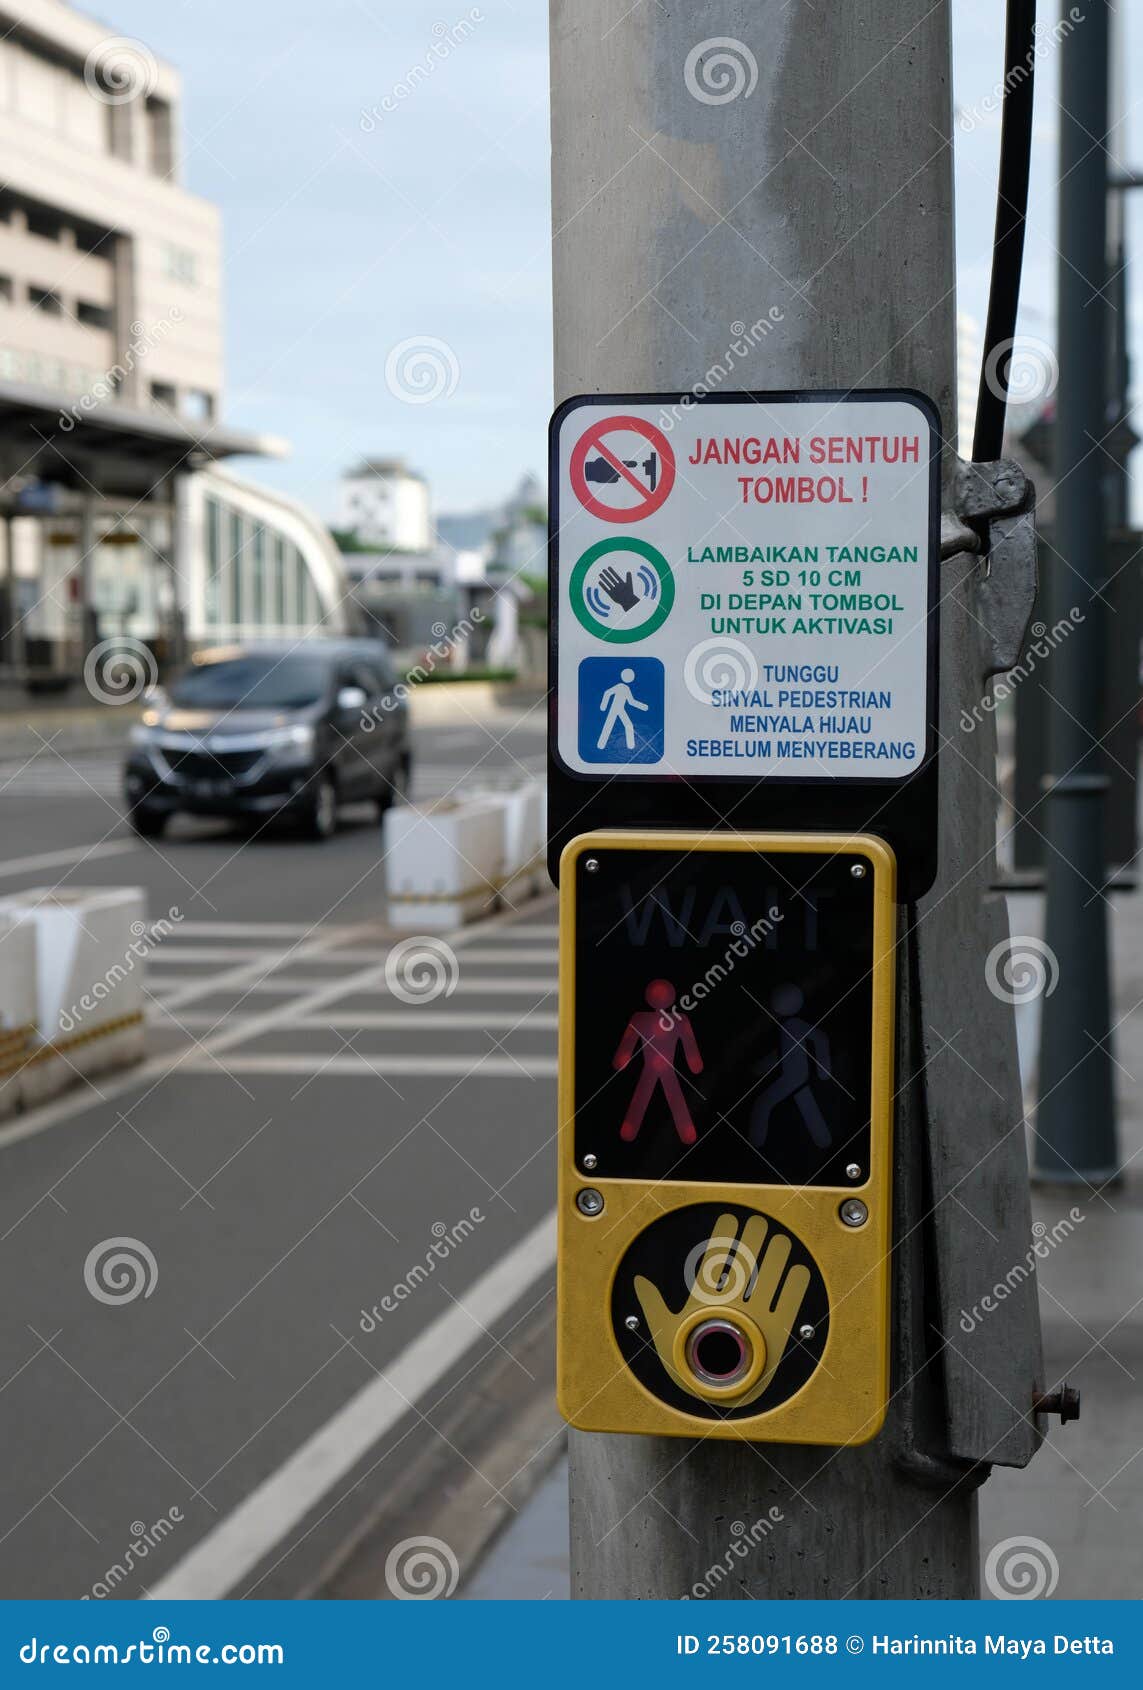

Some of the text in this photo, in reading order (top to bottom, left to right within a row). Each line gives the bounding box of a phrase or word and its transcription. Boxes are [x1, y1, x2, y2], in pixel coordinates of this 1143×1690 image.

[688, 436, 920, 465] JANGAN SENTUH
[738, 476, 869, 504] TOMBOL !
[687, 546, 919, 564] LAMBAIKAN TANGAN
[742, 570, 862, 587] 5 SD 10 CM
[700, 594, 905, 611] DI DEPAN TOMBOL
[711, 617, 894, 635] UNTUK AKTIVASI
[763, 664, 839, 684] TUNGGU
[711, 689, 892, 709] SINYAL PEDESTRIAN
[730, 715, 872, 734] MENYALA HIJAU
[686, 739, 916, 760] SEBELUM MENYEBERANG
[619, 882, 836, 951] WAIT
